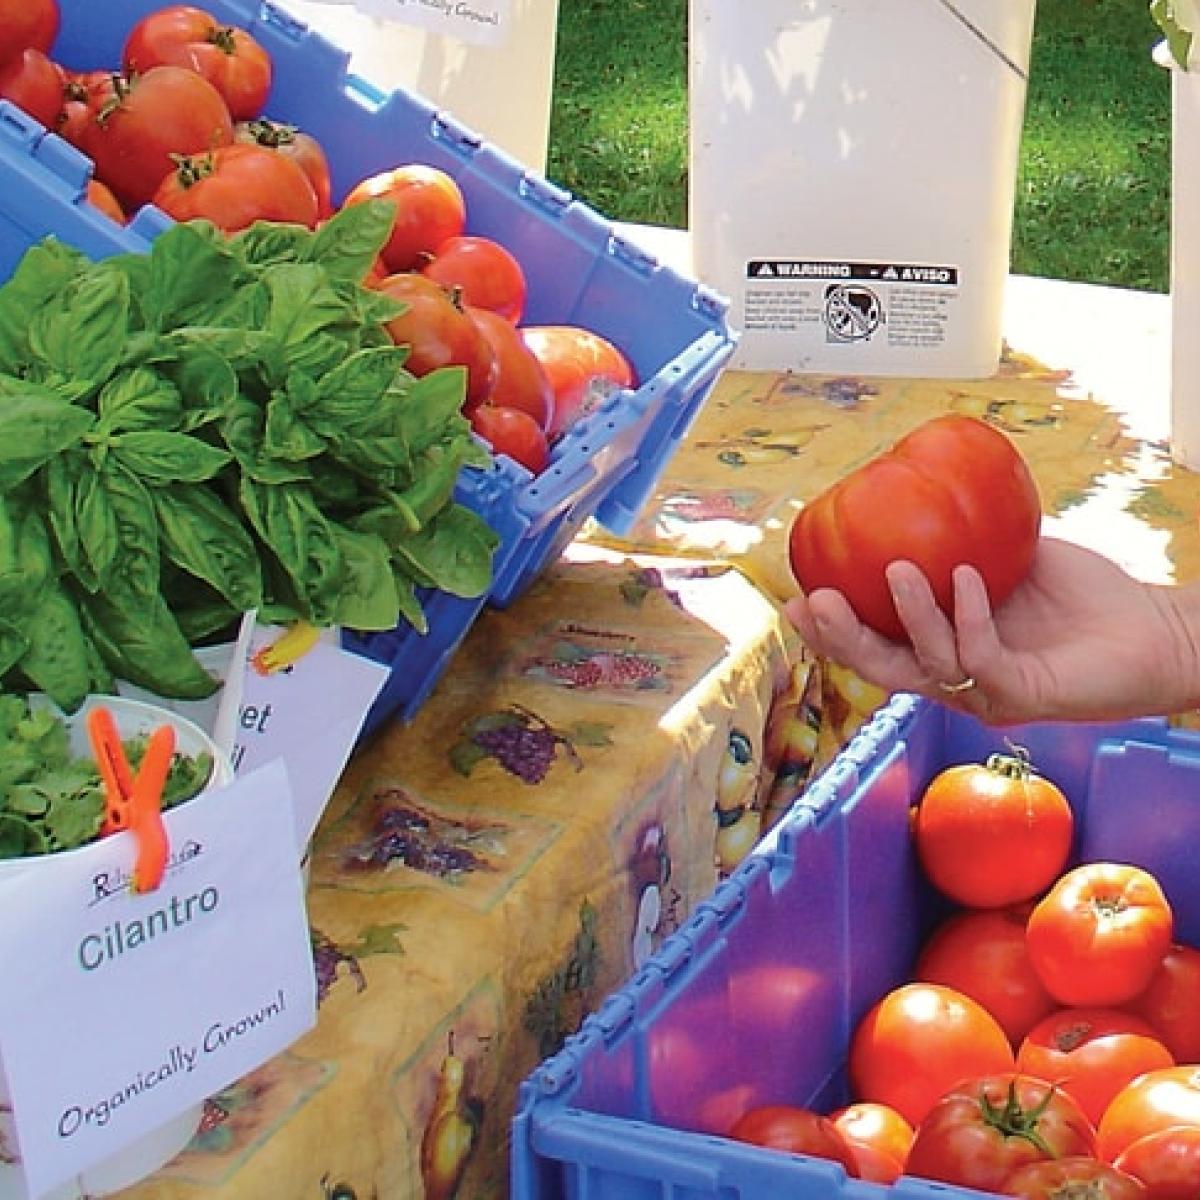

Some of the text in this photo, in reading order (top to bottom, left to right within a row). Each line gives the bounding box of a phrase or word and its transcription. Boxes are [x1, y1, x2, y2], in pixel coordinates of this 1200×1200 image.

[775, 263, 951, 282] WARNING AVISO
[78, 883, 221, 972] Cilantro
[57, 989, 288, 1139] Organically Grown!
